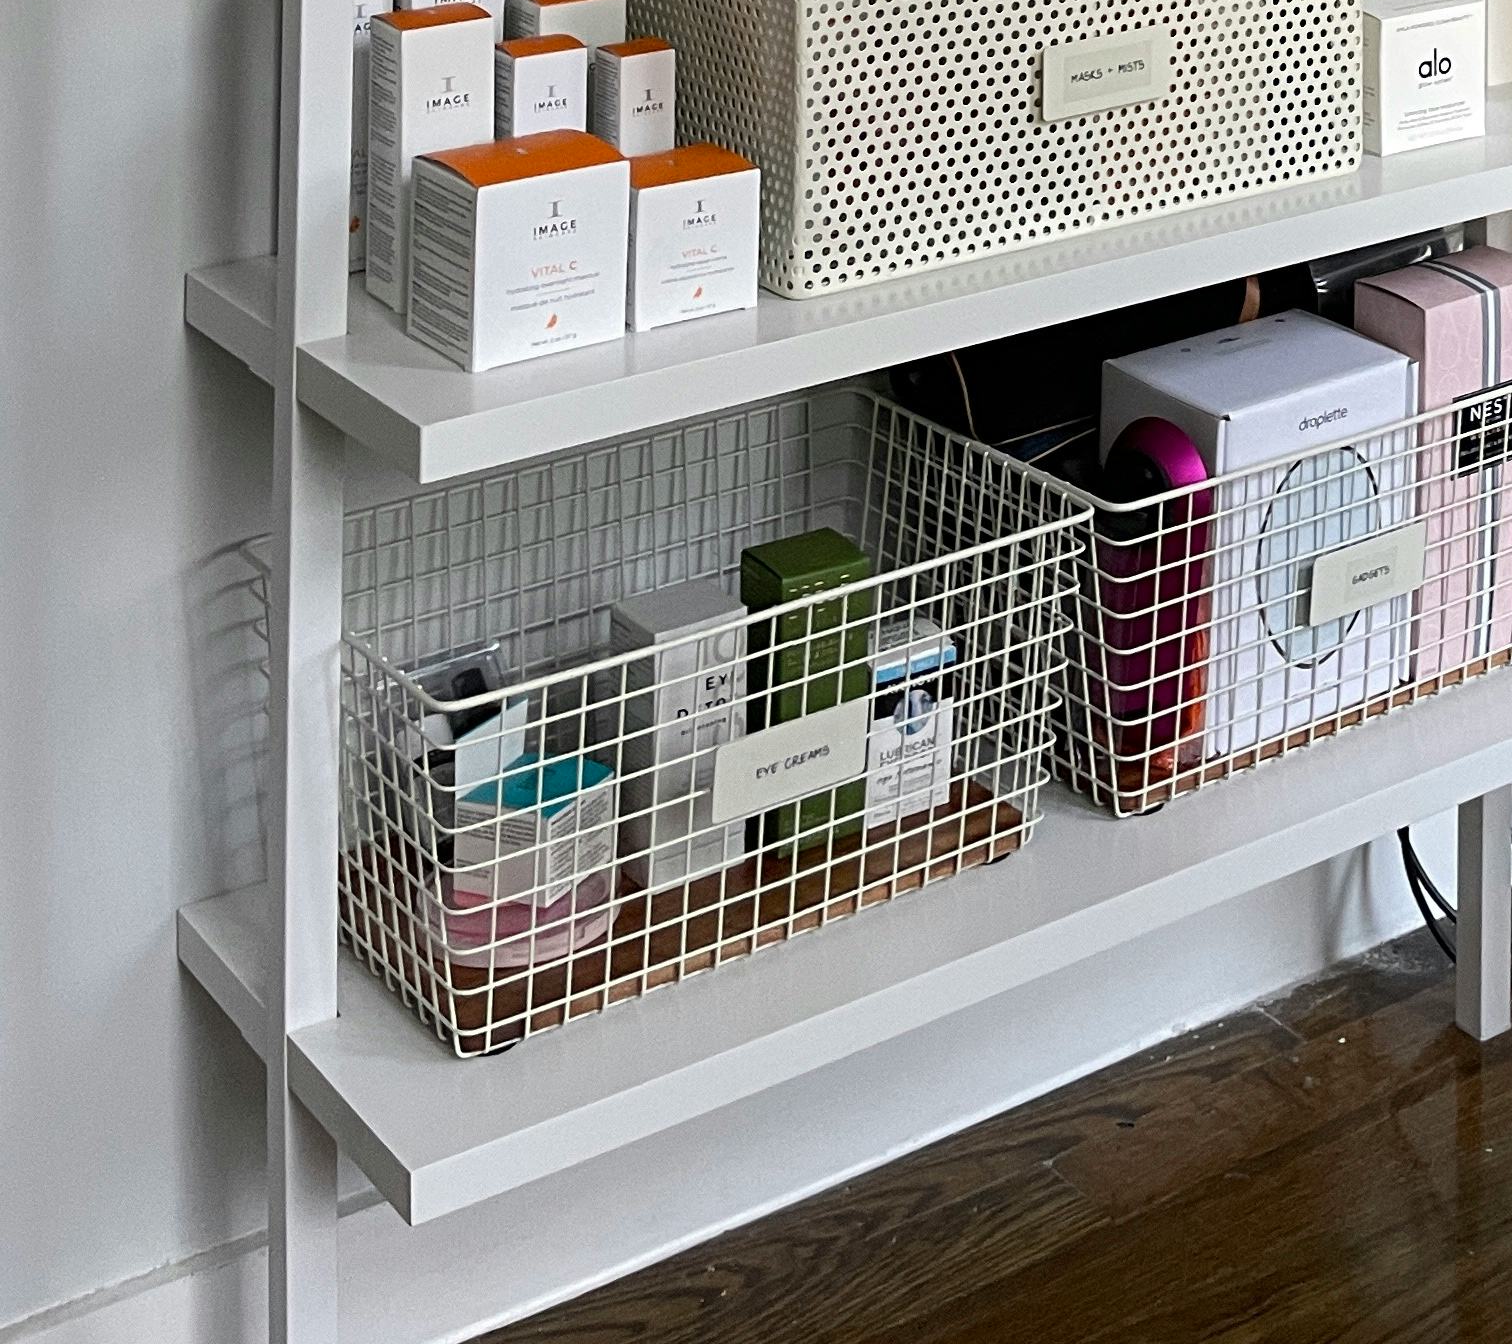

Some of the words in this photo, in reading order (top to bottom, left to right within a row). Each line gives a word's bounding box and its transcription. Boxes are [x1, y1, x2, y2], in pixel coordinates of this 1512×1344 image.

[1071, 68, 1103, 83] MASKS
[1118, 59, 1145, 73] MISTS
[1418, 47, 1452, 79] alo
[427, 93, 469, 109] IMAGE
[534, 98, 568, 111] IMAGE
[632, 102, 664, 114] IMAGE
[533, 219, 577, 236] IMAGE
[683, 214, 716, 228] IMAGE
[682, 248, 708, 258] VITAL
[710, 244, 717, 253] C
[531, 263, 565, 278] VITAL
[569, 261, 578, 271] C
[1469, 397, 1508, 422] NES
[1298, 407, 1348, 431] droplette
[1351, 565, 1390, 585] GADGETS
[705, 673, 728, 691] EY
[756, 762, 779, 779] EYE
[784, 744, 831, 769] CREAMS
